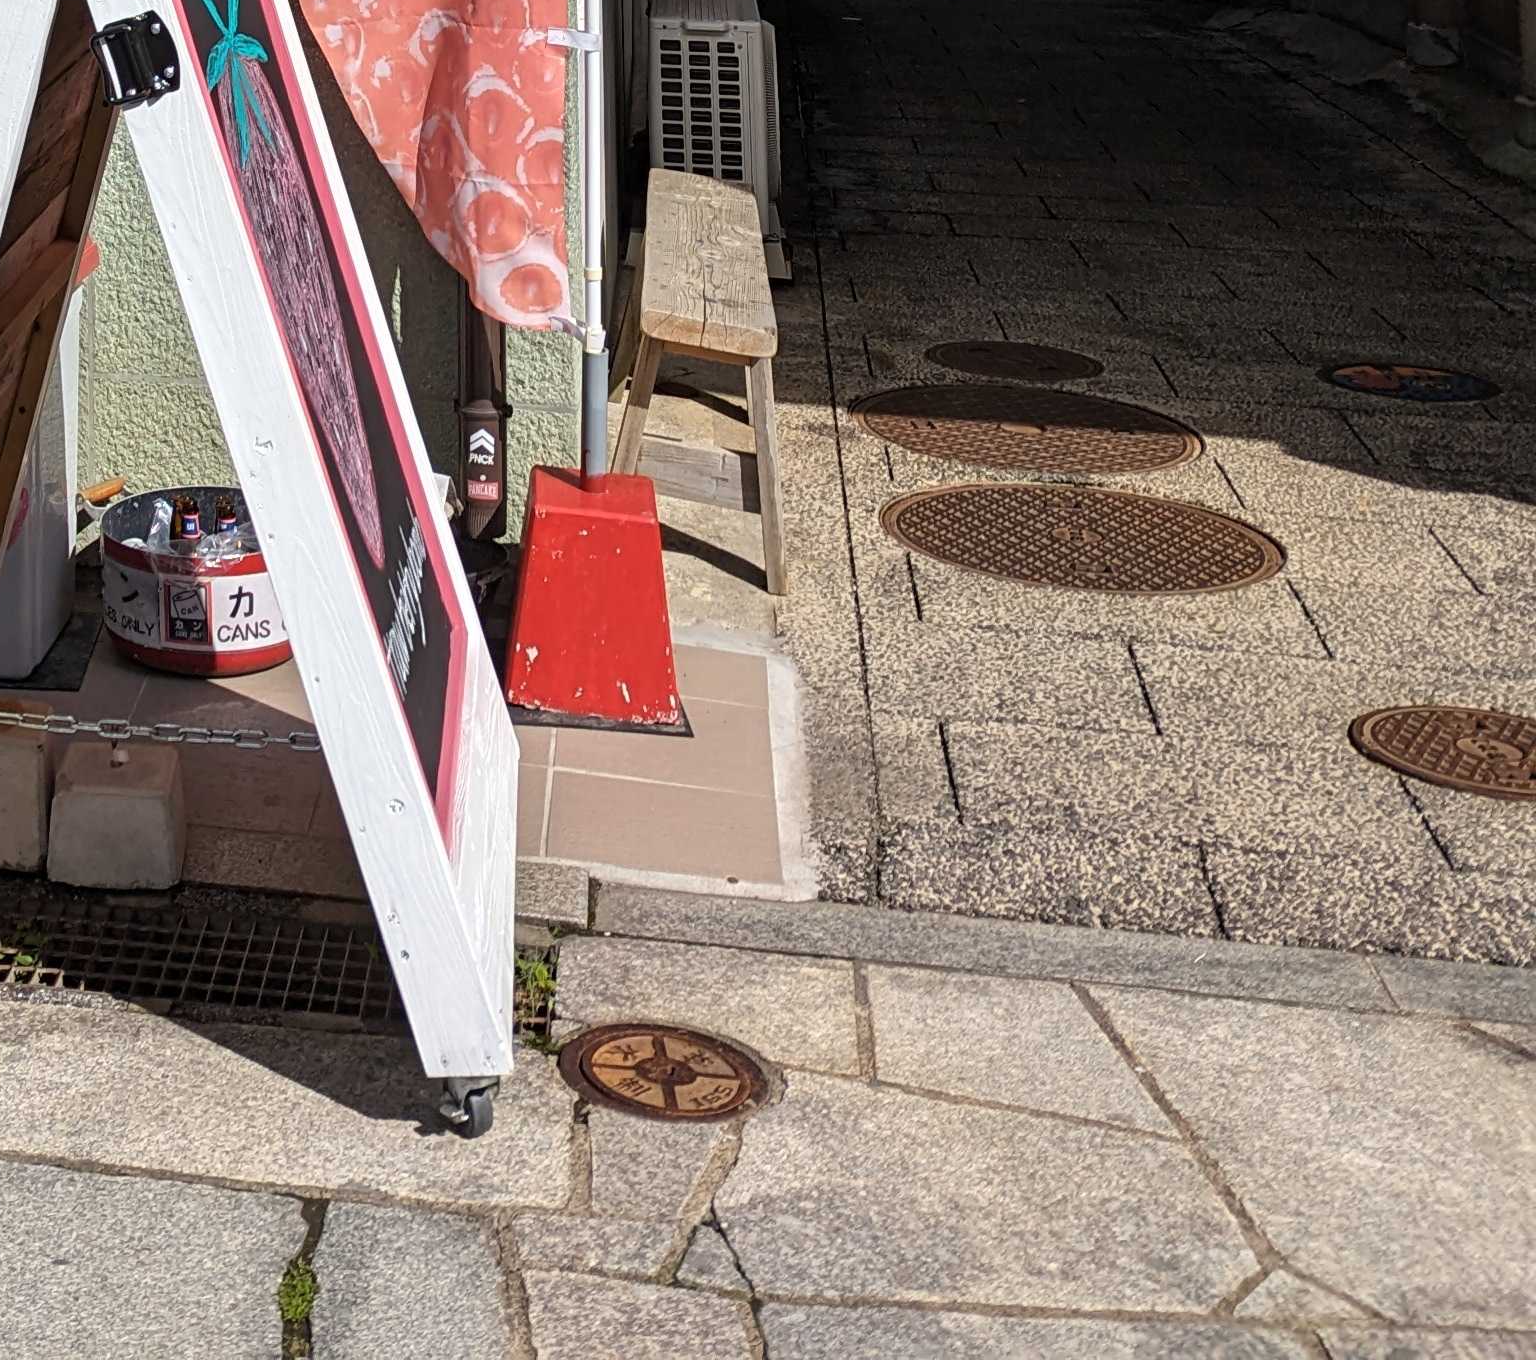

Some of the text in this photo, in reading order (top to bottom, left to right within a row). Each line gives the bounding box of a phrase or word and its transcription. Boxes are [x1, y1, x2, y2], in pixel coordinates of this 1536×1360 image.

[229, 586, 254, 618] カ
[122, 615, 155, 636] ONLY
[216, 620, 272, 642] CANS
